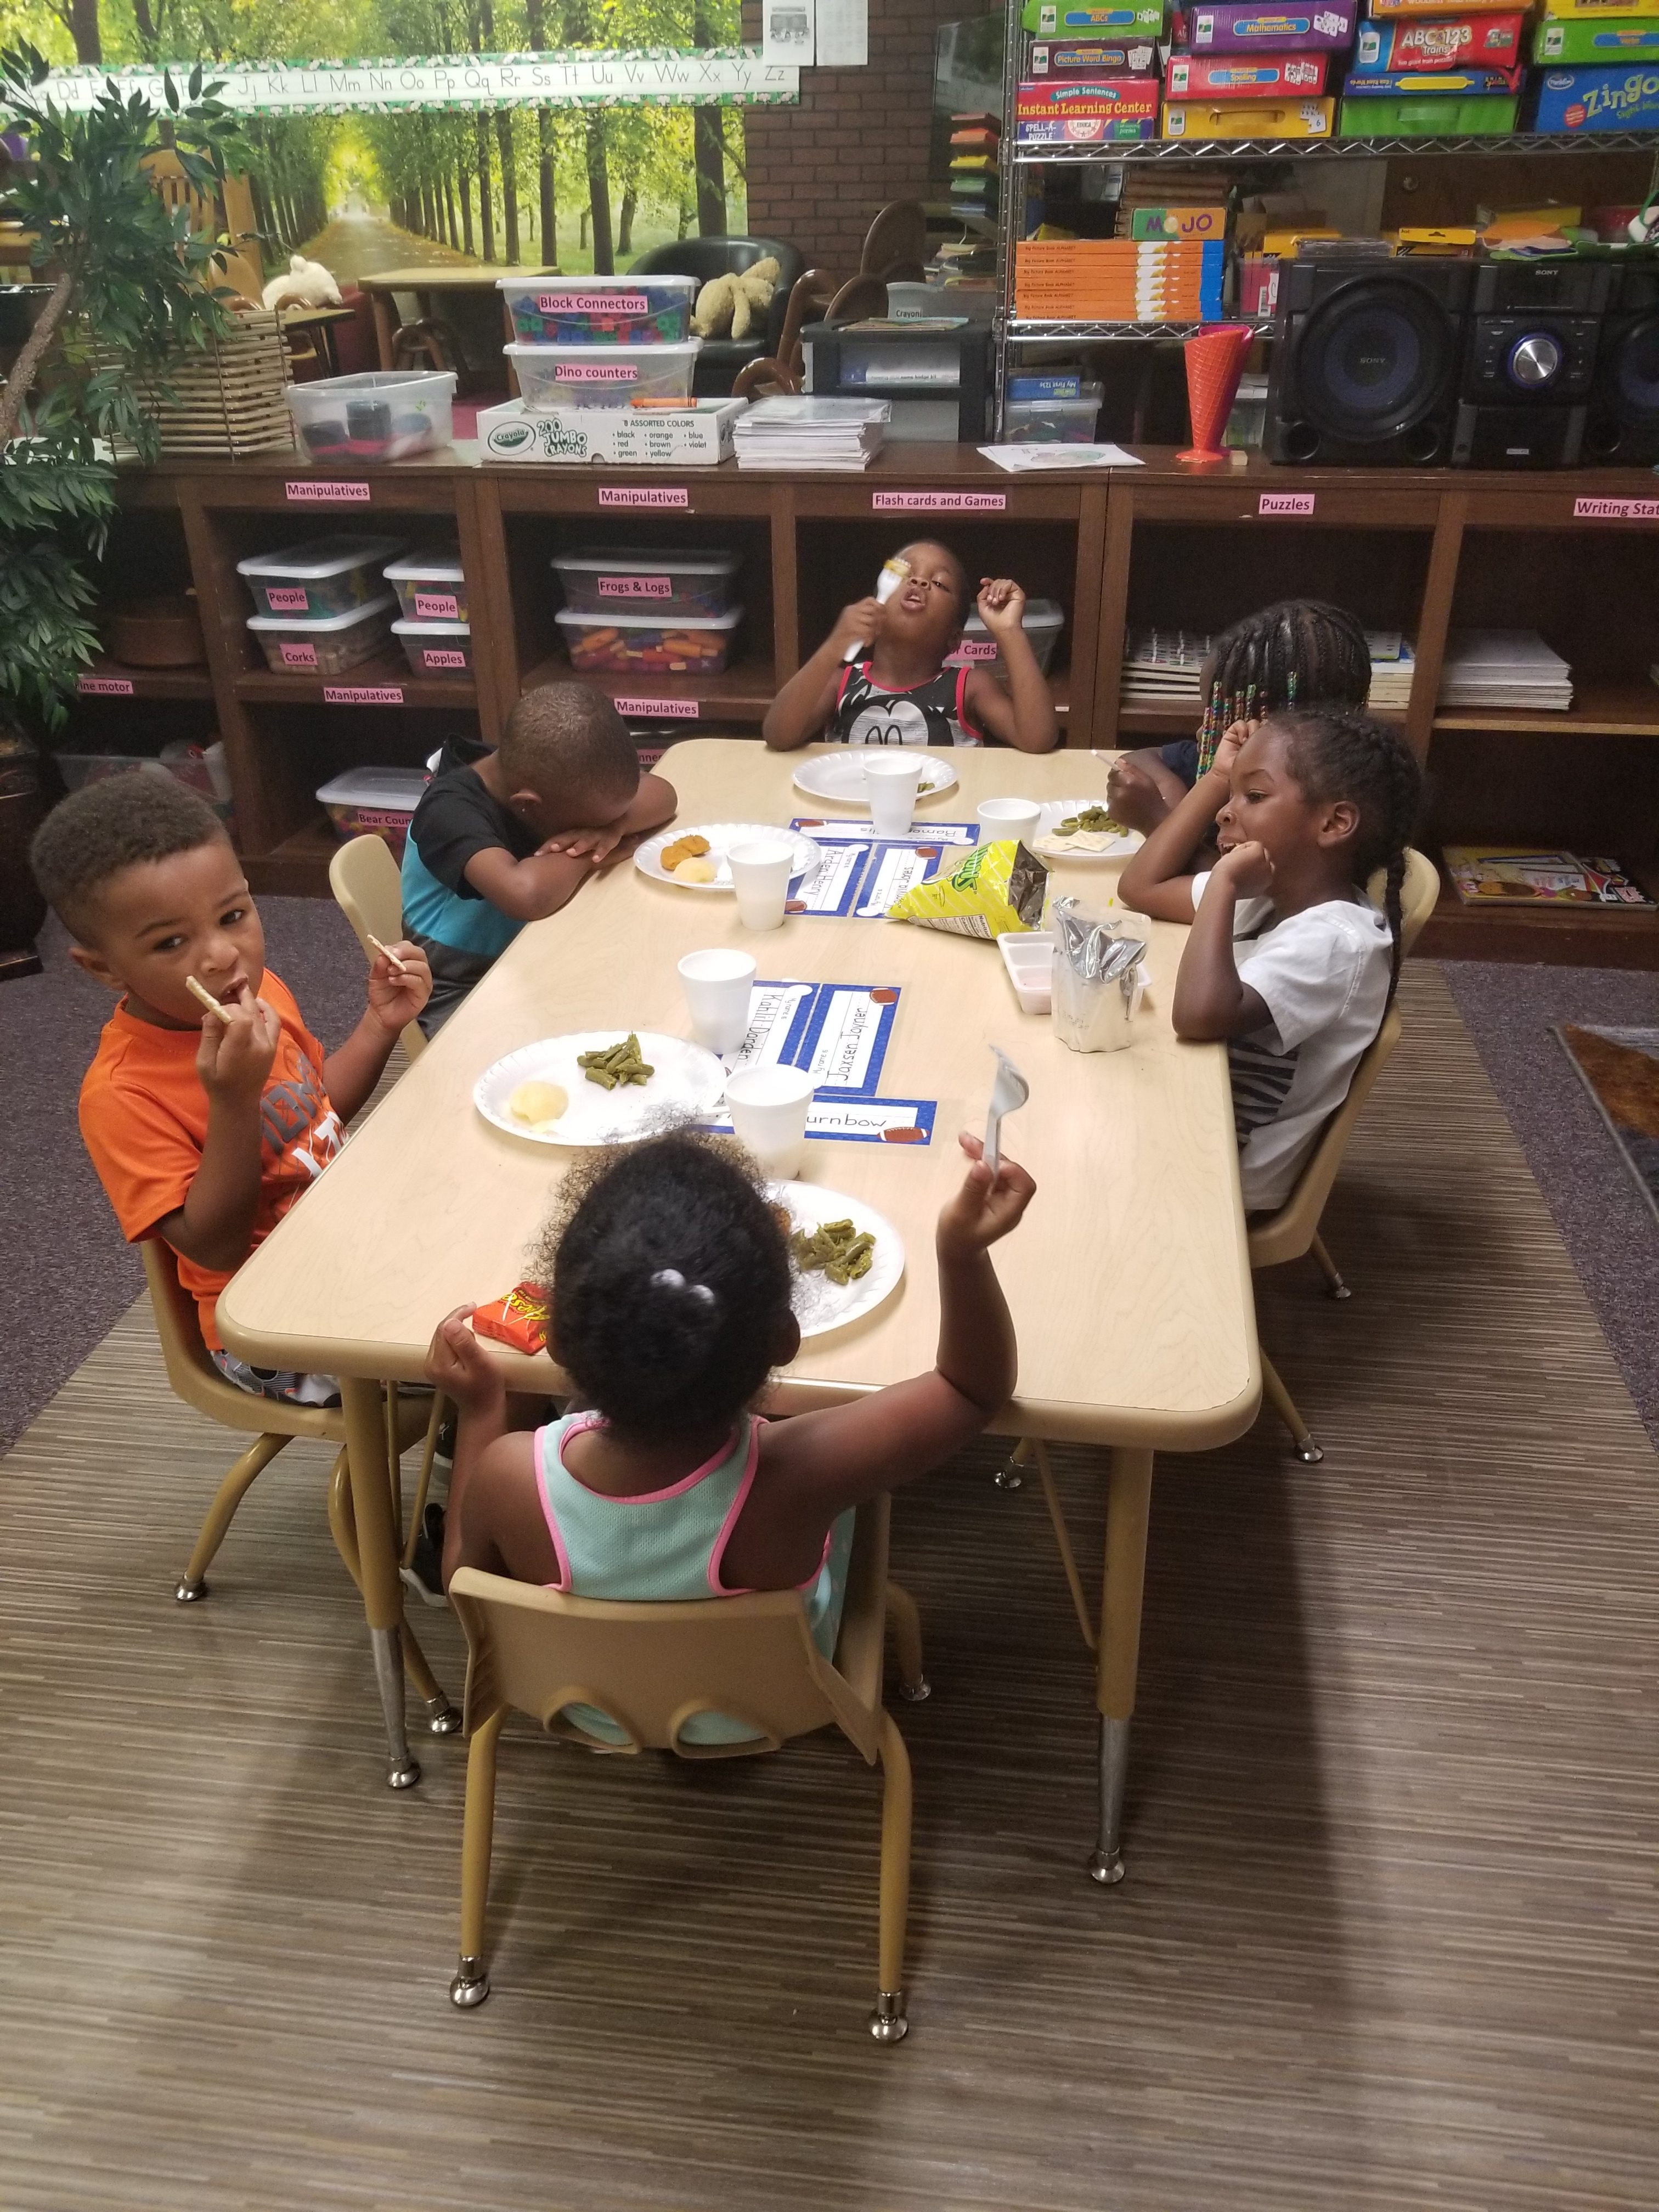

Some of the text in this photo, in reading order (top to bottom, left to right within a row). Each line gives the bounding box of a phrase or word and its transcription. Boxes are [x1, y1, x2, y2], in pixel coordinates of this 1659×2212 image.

[1246, 23, 1296, 33] Mathematics
[1402, 30, 1436, 47] ABC
[1444, 27, 1470, 44] 123
[238, 76, 257, 103] Jj
[267, 75, 289, 94] Kk
[329, 72, 361, 93] Mm
[369, 71, 392, 91] Nn
[400, 70, 425, 90] Oo
[434, 69, 456, 98] Pp
[464, 68, 494, 96] Qq
[500, 67, 521, 87] Rr
[532, 66, 551, 86] Ss
[558, 65, 579, 85] Tt
[591, 64, 613, 84] Uu
[624, 63, 645, 83] Vv
[654, 63, 690, 83] Ww
[699, 63, 721, 83] Xx
[731, 62, 752, 91] Yy
[1056, 86, 1117, 100] Simple Sentences
[1582, 74, 1659, 117] Zingo
[1017, 102, 1152, 115] Instant Learning Center
[1029, 133, 1054, 141] PUZZLE
[540, 296, 645, 310] Block Connectors
[555, 365, 637, 379] Dino counters
[537, 417, 562, 436] 200
[496, 429, 525, 441] Crayola
[543, 429, 588, 446] JUMBO
[544, 443, 588, 458] CRAYONS
[287, 484, 368, 498] Manipulatives
[601, 490, 686, 505] Manipulatives
[875, 495, 1004, 507] Flash cards and Games
[1262, 498, 1310, 510] Puzzles
[1577, 501, 1629, 517] Writing
[600, 581, 670, 595] Frogs & Logs
[269, 592, 305, 604] People
[417, 600, 456, 613] People
[285, 652, 314, 662] Corks
[964, 645, 996, 655] Cards
[426, 653, 463, 665] Apples
[99, 681, 130, 692] motor
[325, 690, 402, 702] Manipulatives
[617, 700, 697, 716] Manipulatives
[359, 814, 382, 823] Bear
[803, 849, 844, 895] Arden Henry
[737, 1027, 771, 1060] Darden
[827, 1007, 869, 1081] Jaxsen Joyner
[806, 1113, 887, 1127] urnbow
